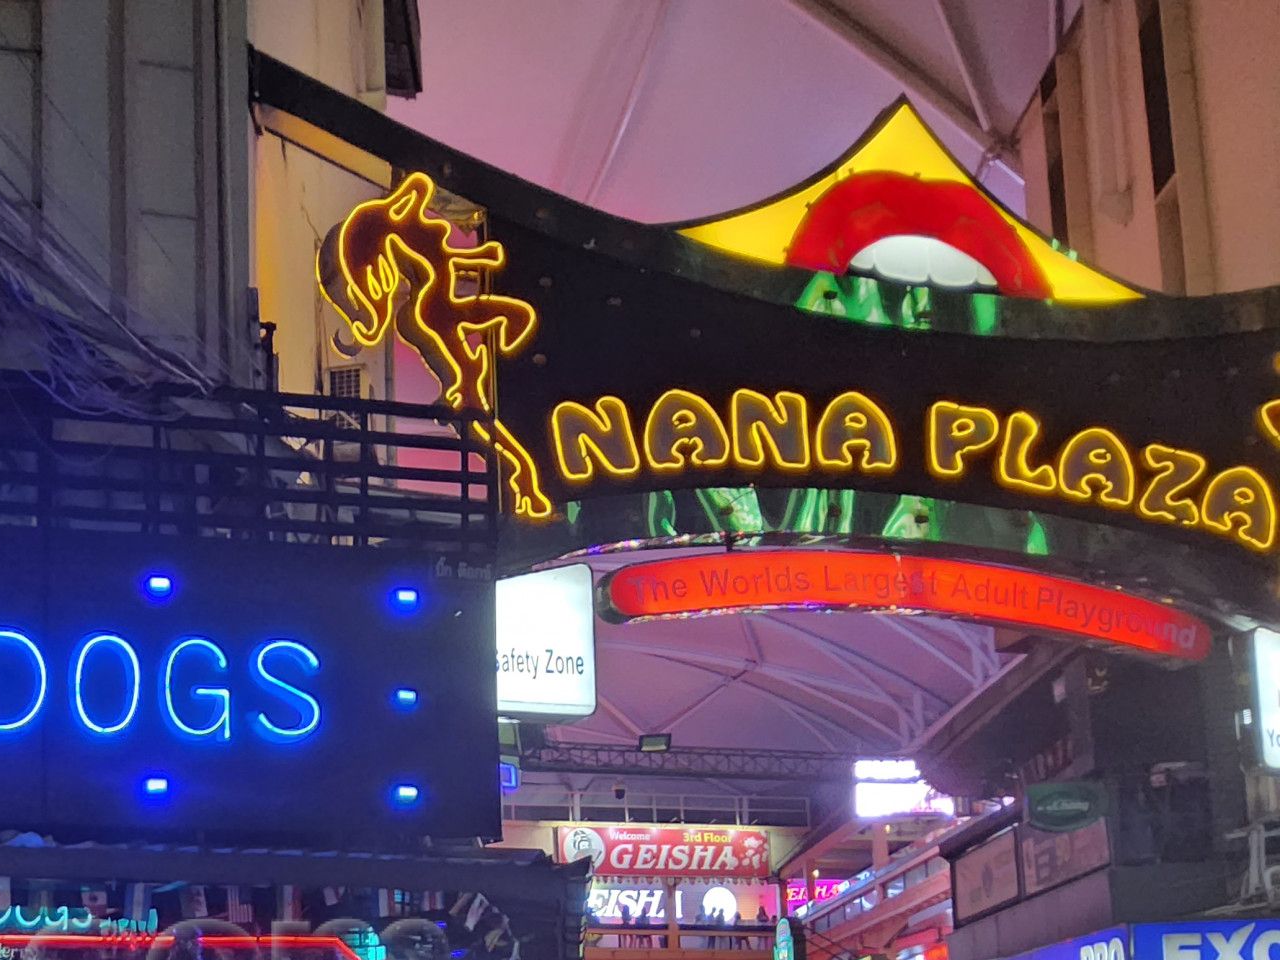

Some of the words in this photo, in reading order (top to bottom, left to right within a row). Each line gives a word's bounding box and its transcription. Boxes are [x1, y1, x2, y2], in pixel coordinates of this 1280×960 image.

[552, 388, 897, 480] NANA
[929, 400, 1276, 549] PLAZA
[628, 575, 688, 604] The
[699, 566, 811, 598] Worlds
[822, 565, 939, 600] Largest
[950, 573, 1030, 609] Adult
[1035, 582, 1198, 649] Playground
[544, 648, 585, 676] Zone
[610, 831, 651, 842] Welcome
[683, 832, 702, 843] 3rd
[704, 833, 732, 844] Floor
[610, 844, 738, 871] GEISHA
